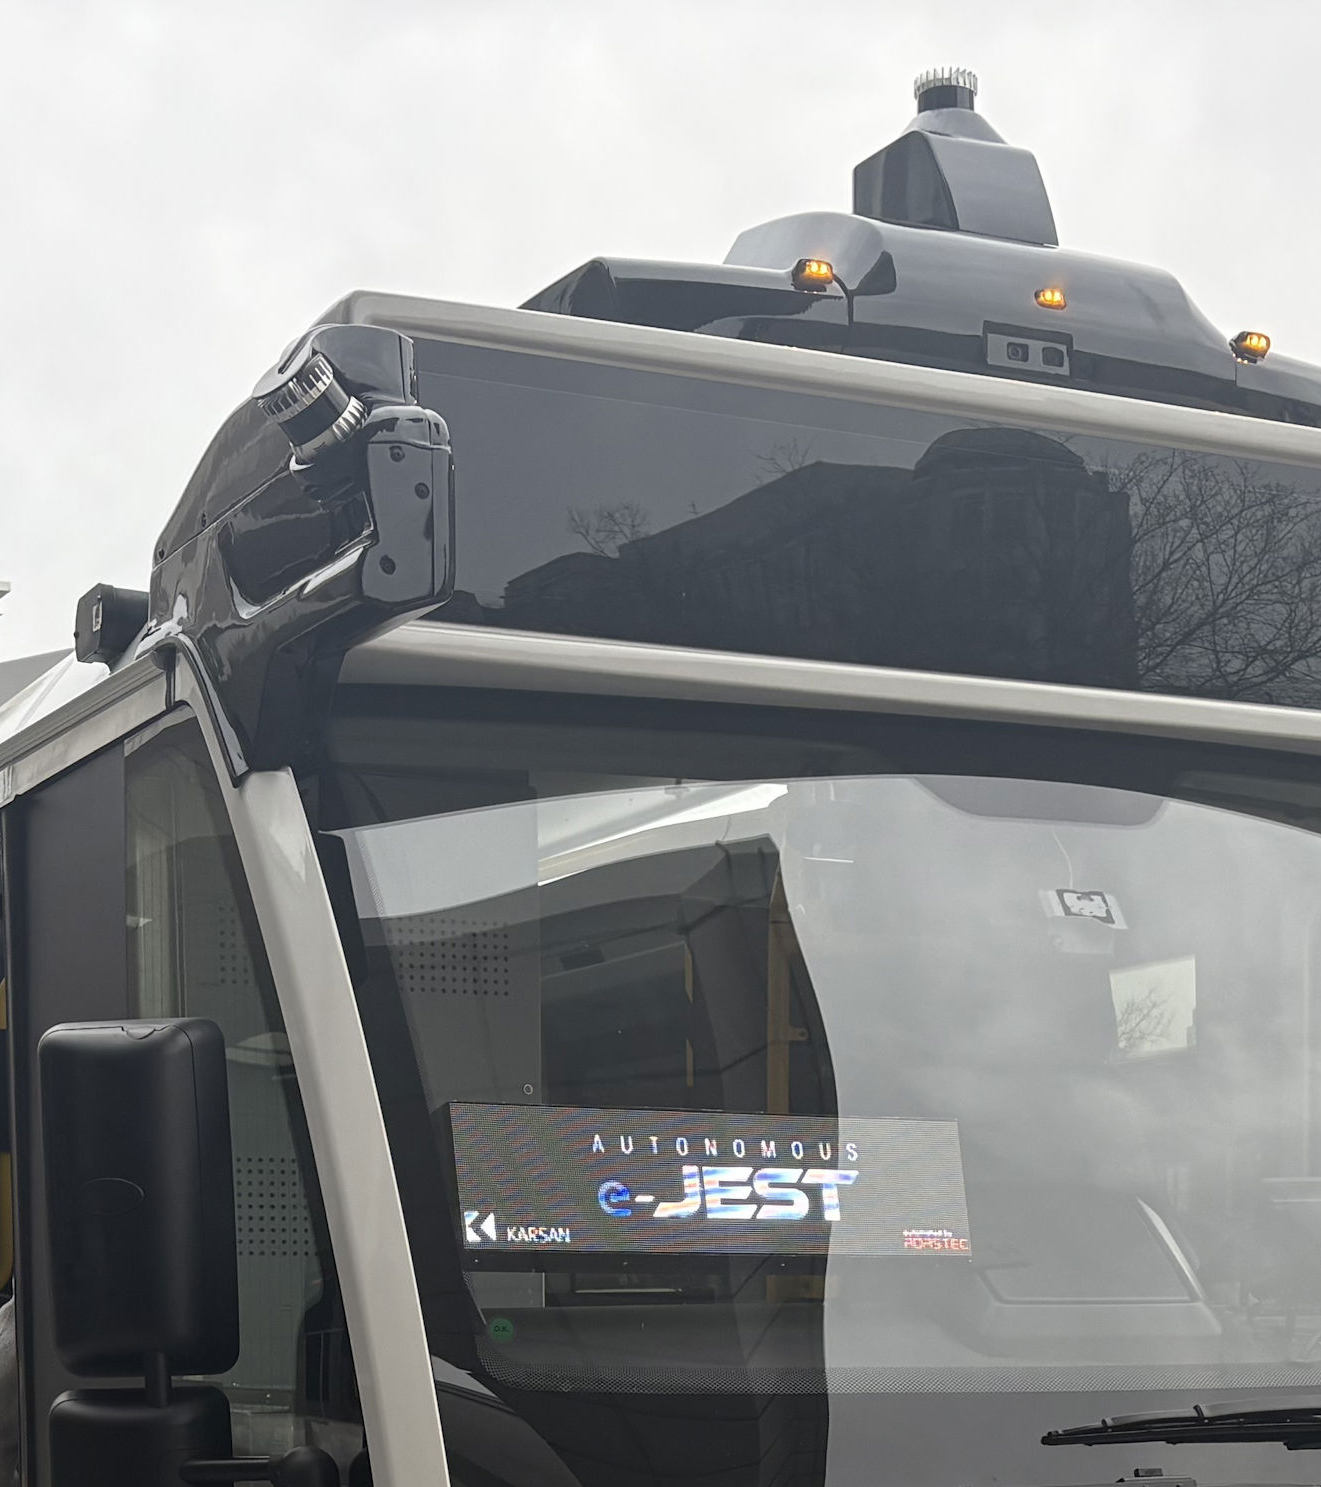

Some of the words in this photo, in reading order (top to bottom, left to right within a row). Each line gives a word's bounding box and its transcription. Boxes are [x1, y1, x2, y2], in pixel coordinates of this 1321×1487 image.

[592, 1133, 859, 1162] AUTONOMOUS
[597, 1164, 860, 1222] e-JEST
[506, 1225, 571, 1244] KARSAN
